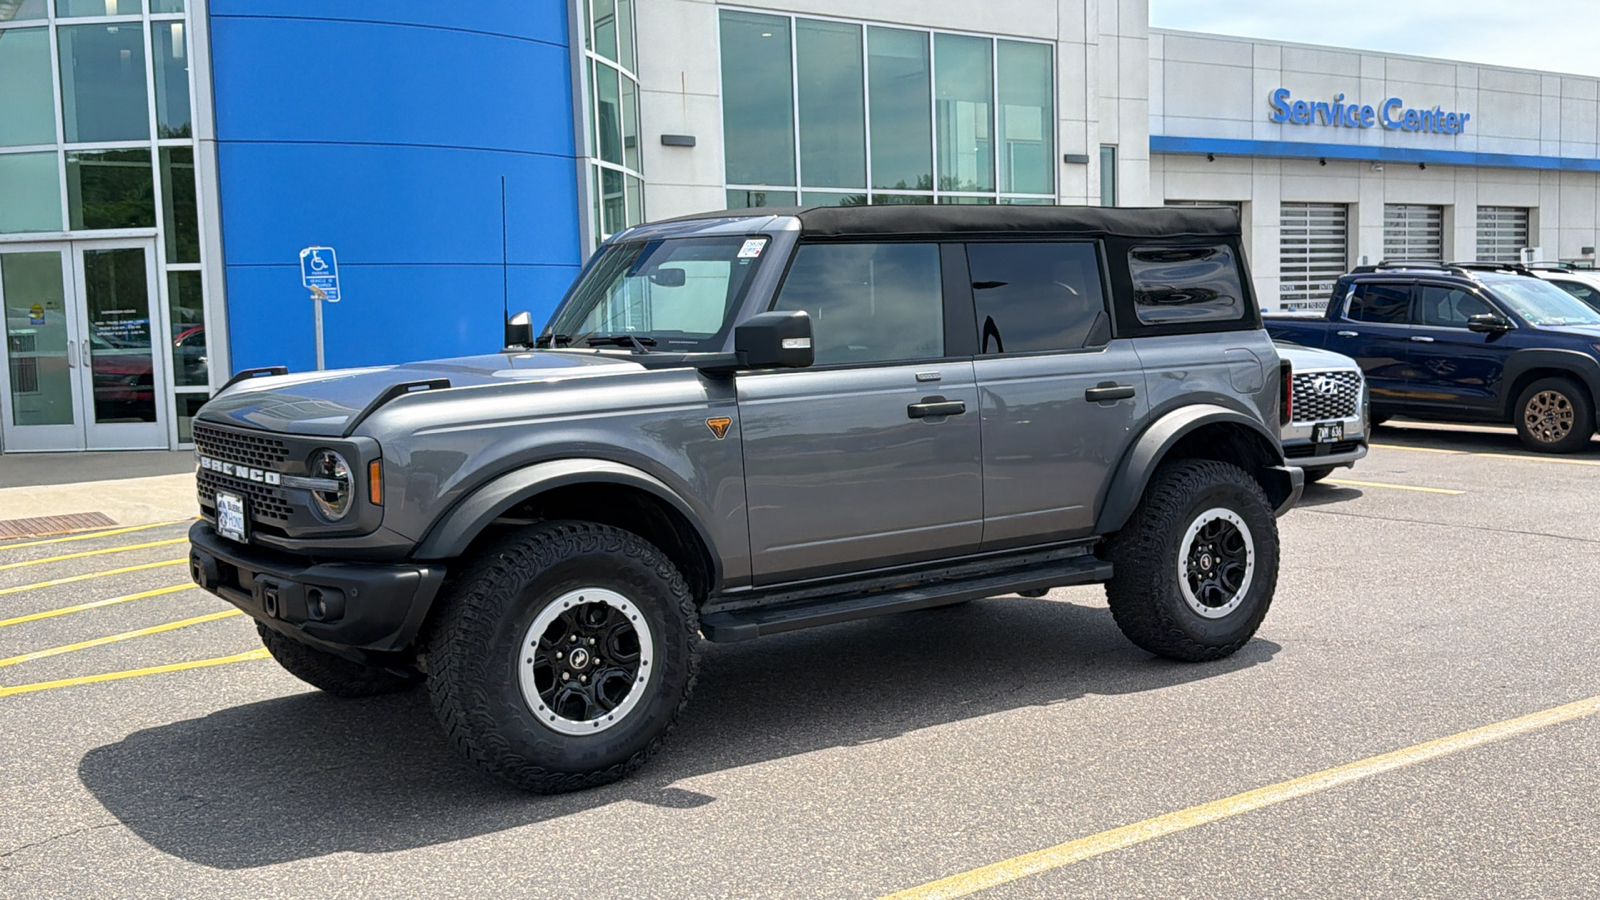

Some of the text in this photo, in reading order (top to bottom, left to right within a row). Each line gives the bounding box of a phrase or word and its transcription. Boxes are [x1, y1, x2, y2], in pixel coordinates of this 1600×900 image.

[1269, 88, 1471, 134] Service Center
[201, 456, 280, 485] BRONCO
